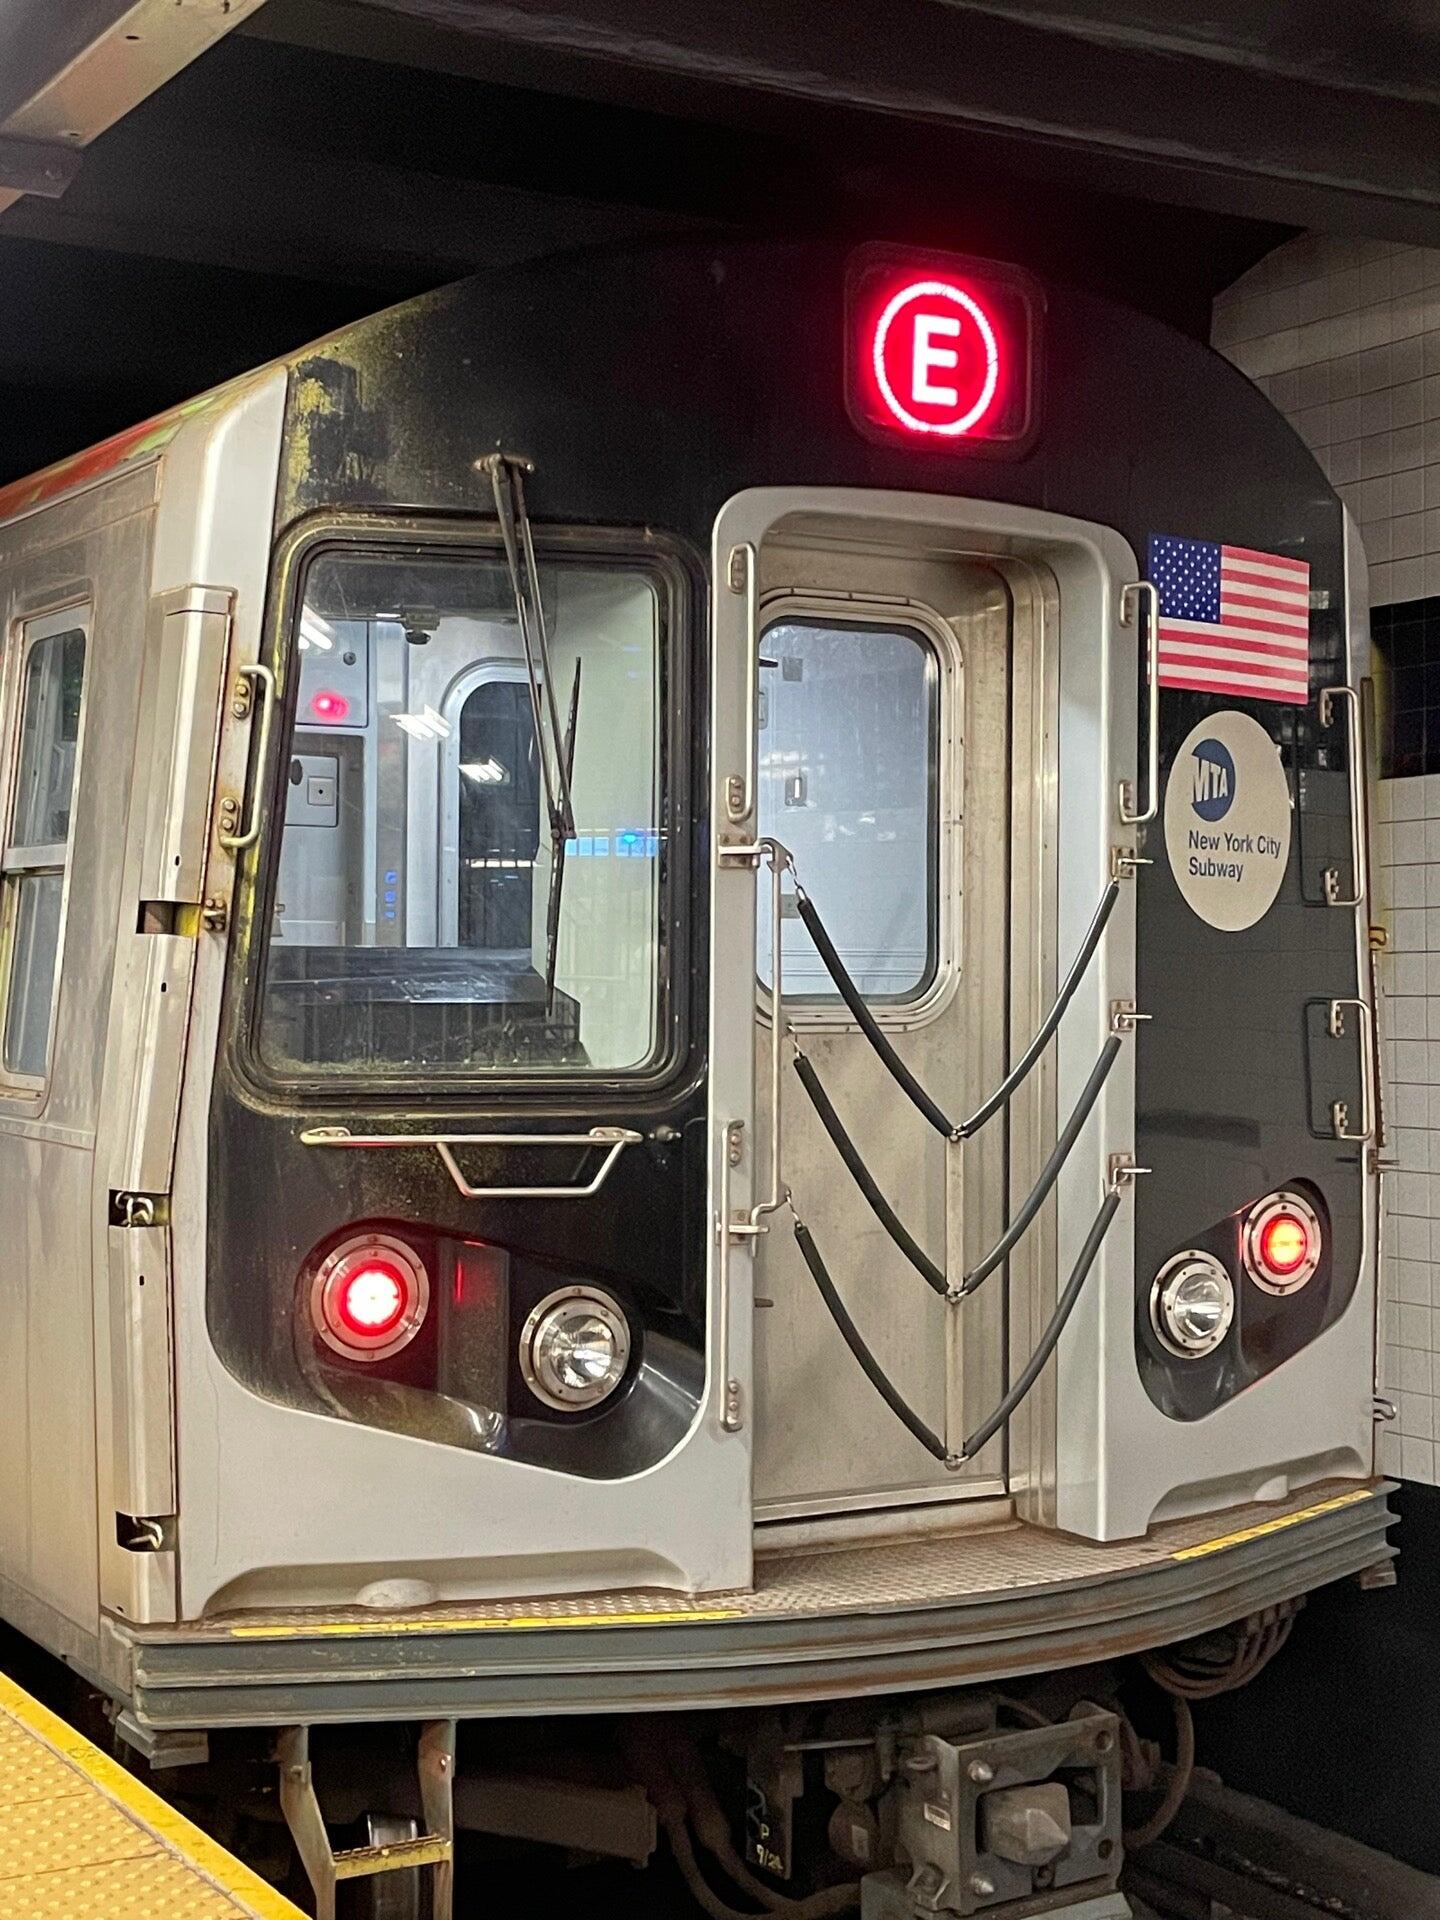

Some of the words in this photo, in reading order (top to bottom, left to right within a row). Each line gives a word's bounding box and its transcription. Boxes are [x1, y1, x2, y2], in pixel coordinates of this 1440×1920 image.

[912, 314, 961, 407] E
[1192, 756, 1229, 802] MTA
[1188, 830, 1220, 851] New
[1224, 832, 1254, 854] York
[1257, 835, 1281, 859] City
[1188, 856, 1244, 882] Subway
